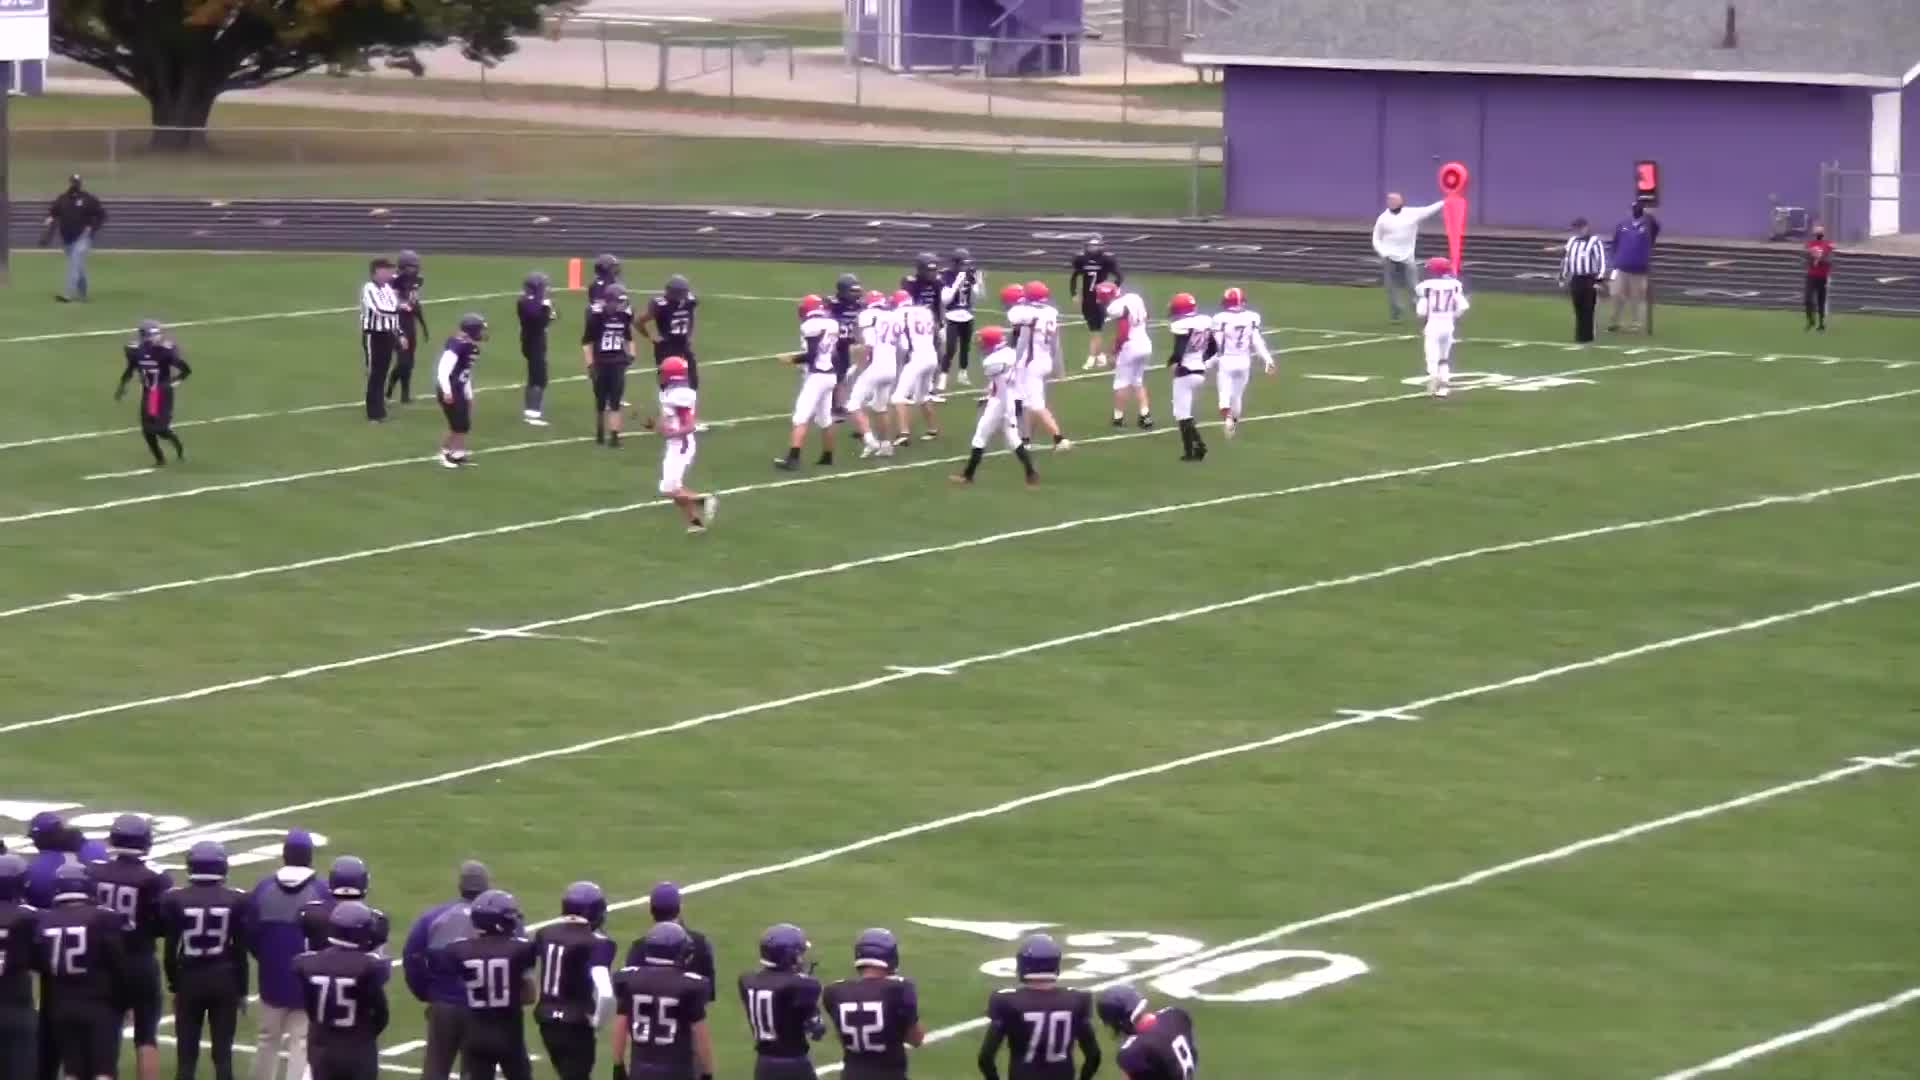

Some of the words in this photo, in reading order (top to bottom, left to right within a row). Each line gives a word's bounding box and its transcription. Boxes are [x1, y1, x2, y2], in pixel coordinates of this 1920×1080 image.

[1637, 163, 1655, 190] 3
[1087, 271, 1098, 292] 7
[1431, 289, 1454, 313] 17
[43, 926, 88, 977] 72
[183, 907, 230, 955] 23
[463, 958, 510, 1008] 20
[543, 943, 564, 996] 11
[979, 930, 1369, 1002] 30
[310, 975, 357, 1027] 75
[631, 993, 680, 1045] 65
[747, 988, 777, 1040] 10
[839, 1002, 886, 1052] 52
[1023, 1010, 1073, 1063] 70
